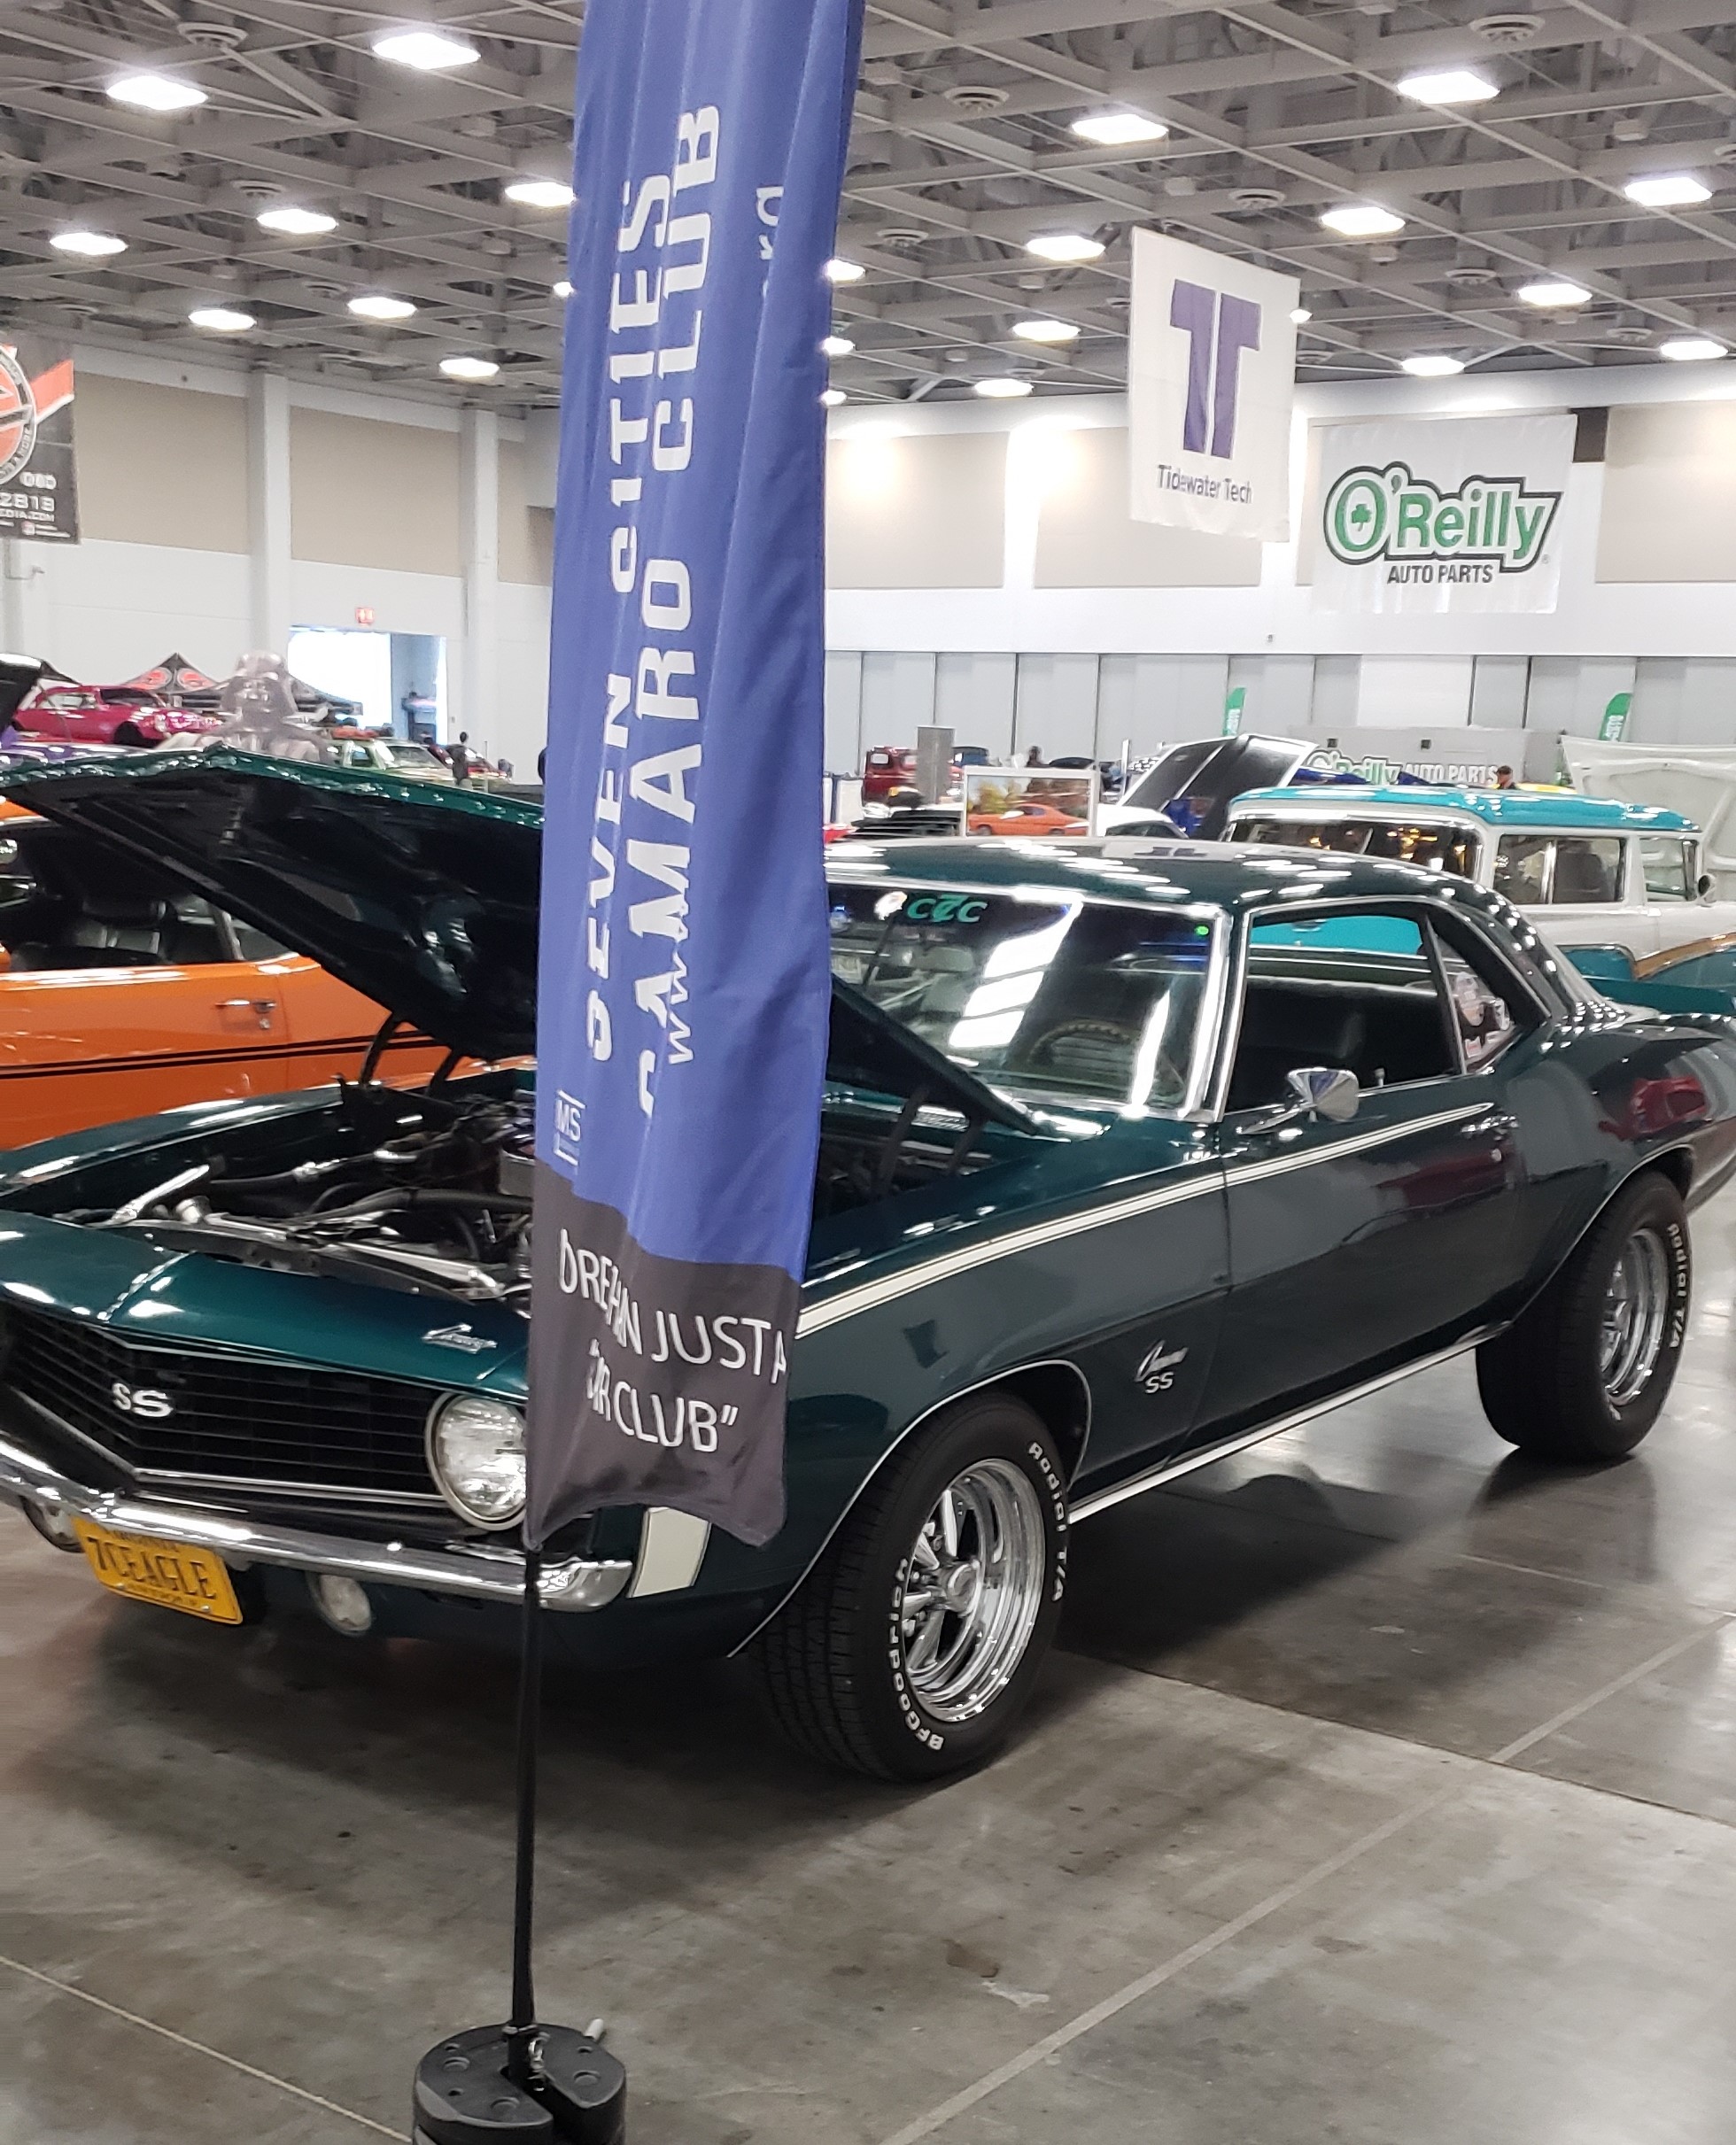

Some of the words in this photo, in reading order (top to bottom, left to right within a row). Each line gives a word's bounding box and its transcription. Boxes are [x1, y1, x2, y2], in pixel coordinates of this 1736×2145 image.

[653, 105, 720, 471] CLUB
[1157, 464, 1221, 499] Tidewater
[1223, 477, 1252, 504] Tech
[1331, 473, 1548, 561] O'Reilly
[1387, 564, 1434, 585] AUTO
[1437, 564, 1494, 585] PARTS
[1448, 763, 1499, 785] PARTS
[650, 1310, 771, 1376] JUST
[112, 1382, 174, 1417] SS
[1144, 1371, 1175, 1394] SS
